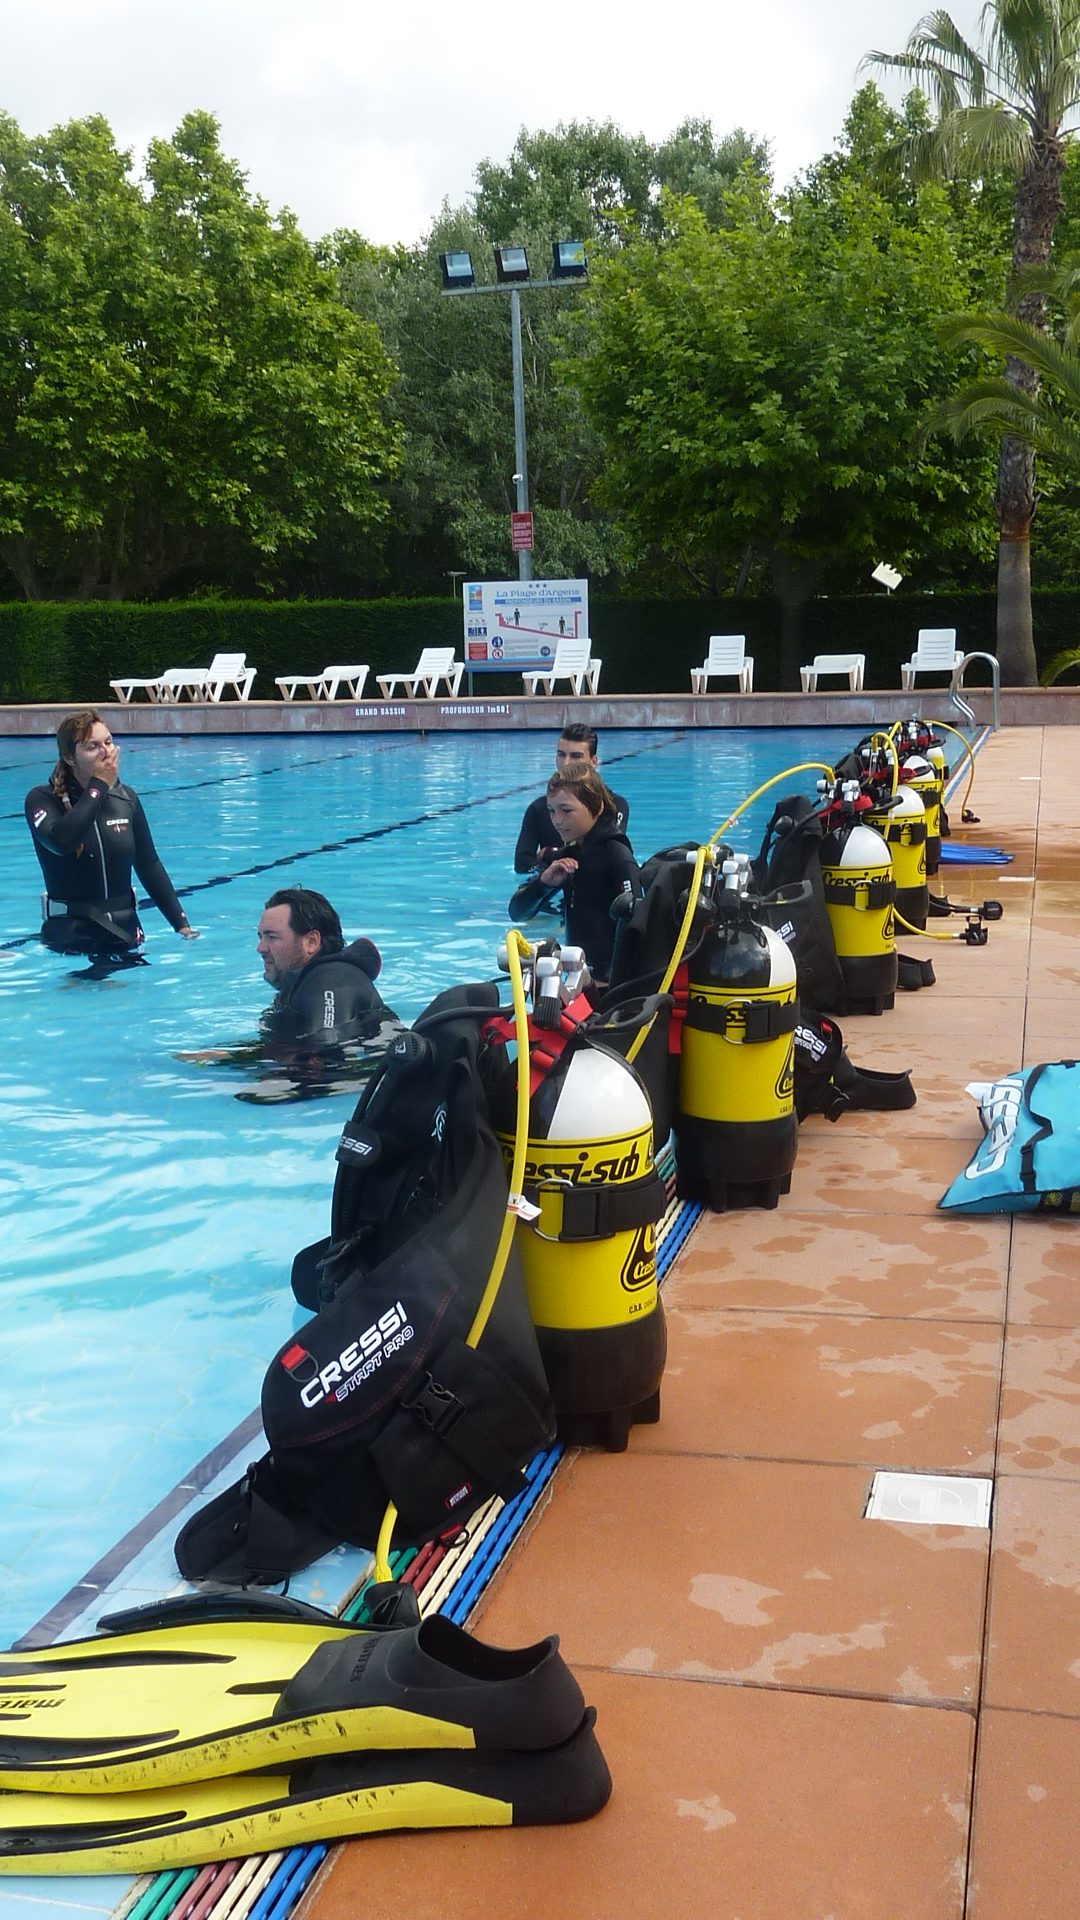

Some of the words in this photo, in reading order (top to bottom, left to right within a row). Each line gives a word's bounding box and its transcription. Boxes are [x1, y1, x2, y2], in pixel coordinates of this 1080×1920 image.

[510, 590, 537, 599] Plage
[538, 588, 580, 598] d'Argens
[355, 707, 378, 716] GRAND
[380, 707, 406, 715] BASSIN
[440, 705, 485, 714] PROFONDEUR
[324, 990, 335, 1029] CRESSI
[794, 1025, 827, 1055] RESSI
[341, 1135, 373, 1156] ESSI
[300, 1300, 408, 1408] CRESSI
[335, 1351, 382, 1402] START
[383, 1325, 414, 1358] PRO
